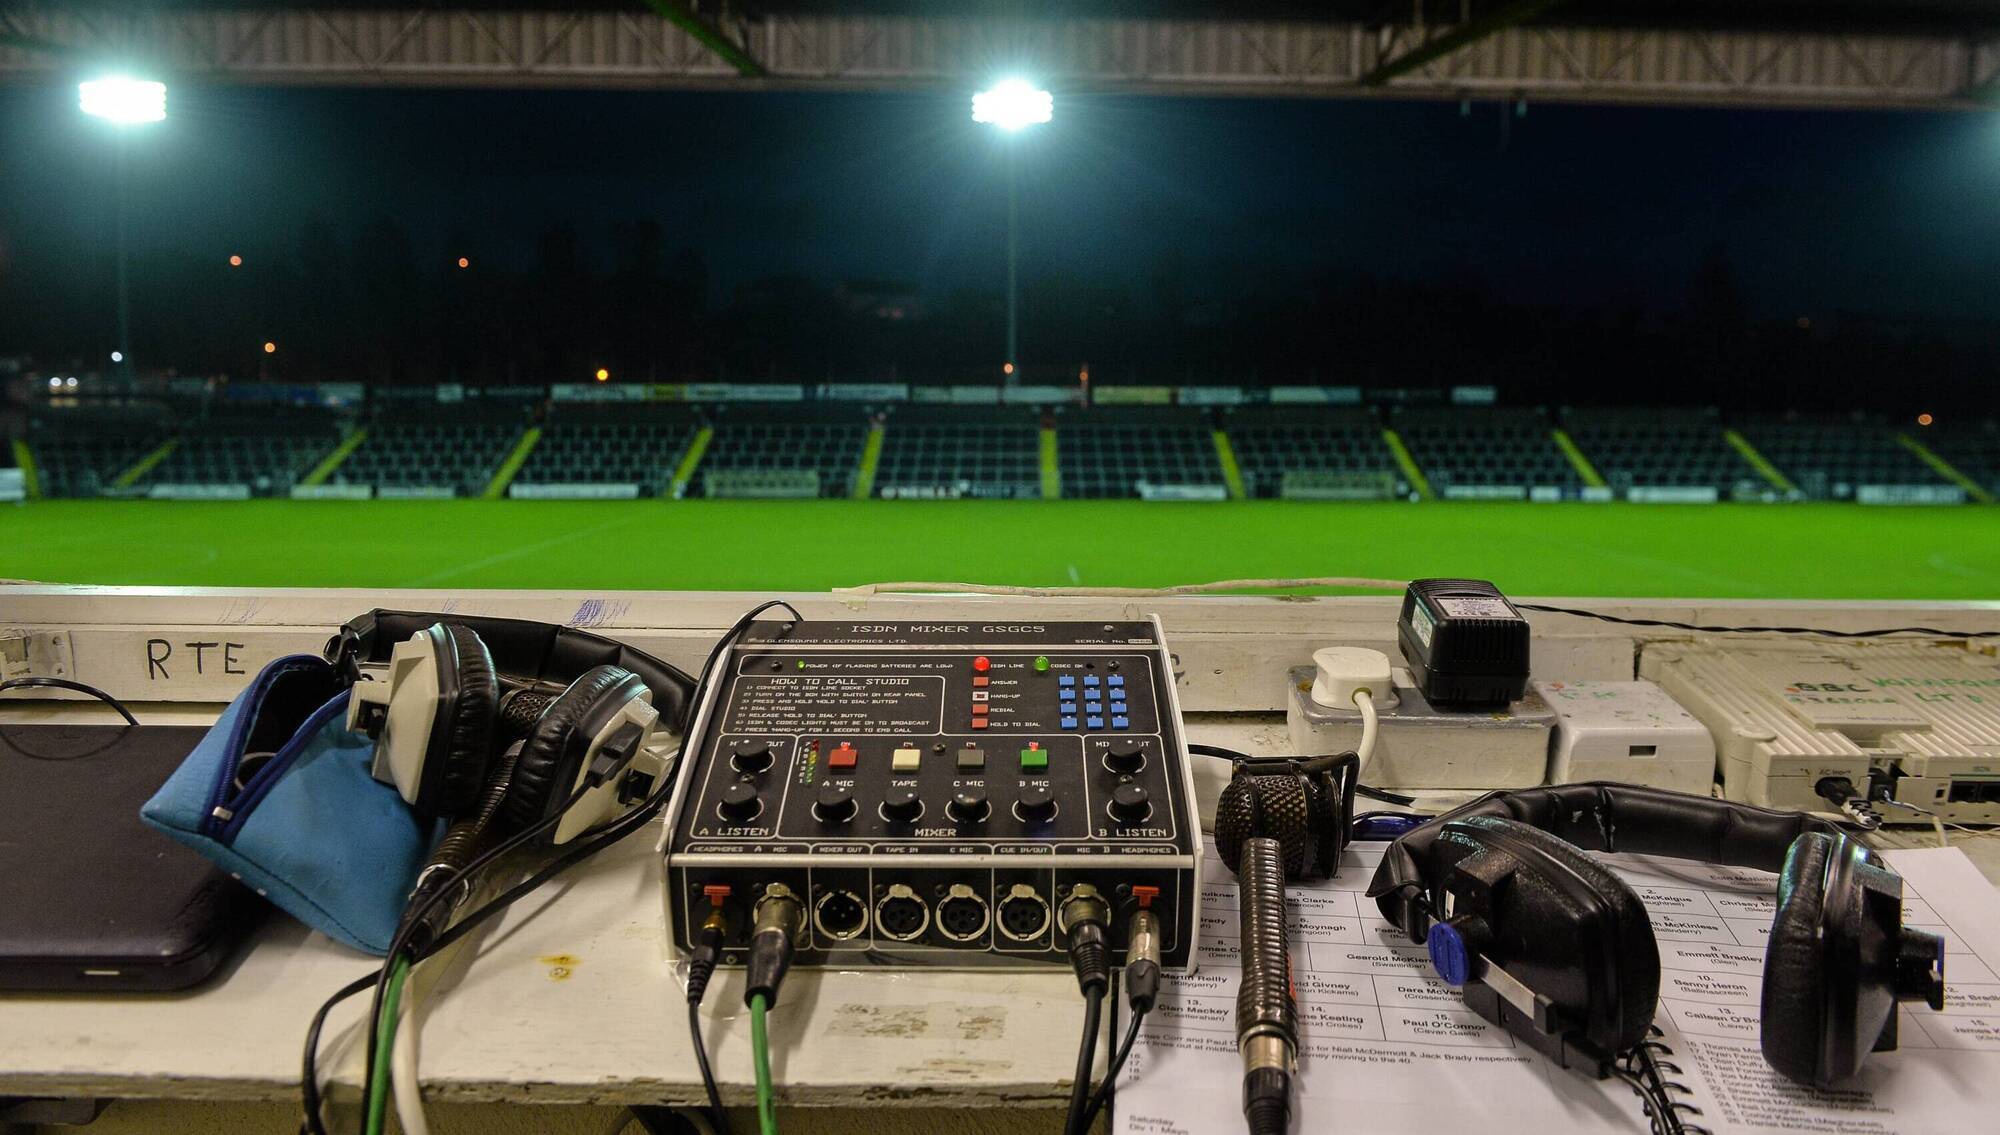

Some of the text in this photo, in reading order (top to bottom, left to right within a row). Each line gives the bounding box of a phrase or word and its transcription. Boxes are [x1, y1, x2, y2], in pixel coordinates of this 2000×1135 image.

[147, 639, 245, 680] RTE
[1793, 682, 1871, 692] BBC
[915, 828, 956, 836] MIXER
[1099, 828, 1166, 836] B LISTEN
[1103, 845, 1109, 853] B
[1303, 897, 1335, 905] Clarke
[1299, 924, 1346, 932] Moynagh
[1677, 951, 1763, 963] Emmett Bradley
[1197, 975, 1228, 983] Reilly
[1313, 982, 1350, 990] Givney
[1674, 979, 1748, 991] Benny Heron
[1398, 986, 1424, 994] Dara
[1159, 1004, 1229, 1016] Cian Mackey
[1320, 1014, 1364, 1023] Keating
[1403, 1019, 1487, 1031] Paul O'Connor
[1356, 1047, 1407, 1057] McDermott
[1420, 1052, 1441, 1060] Jack
[1444, 1053, 1473, 1062] Brady
